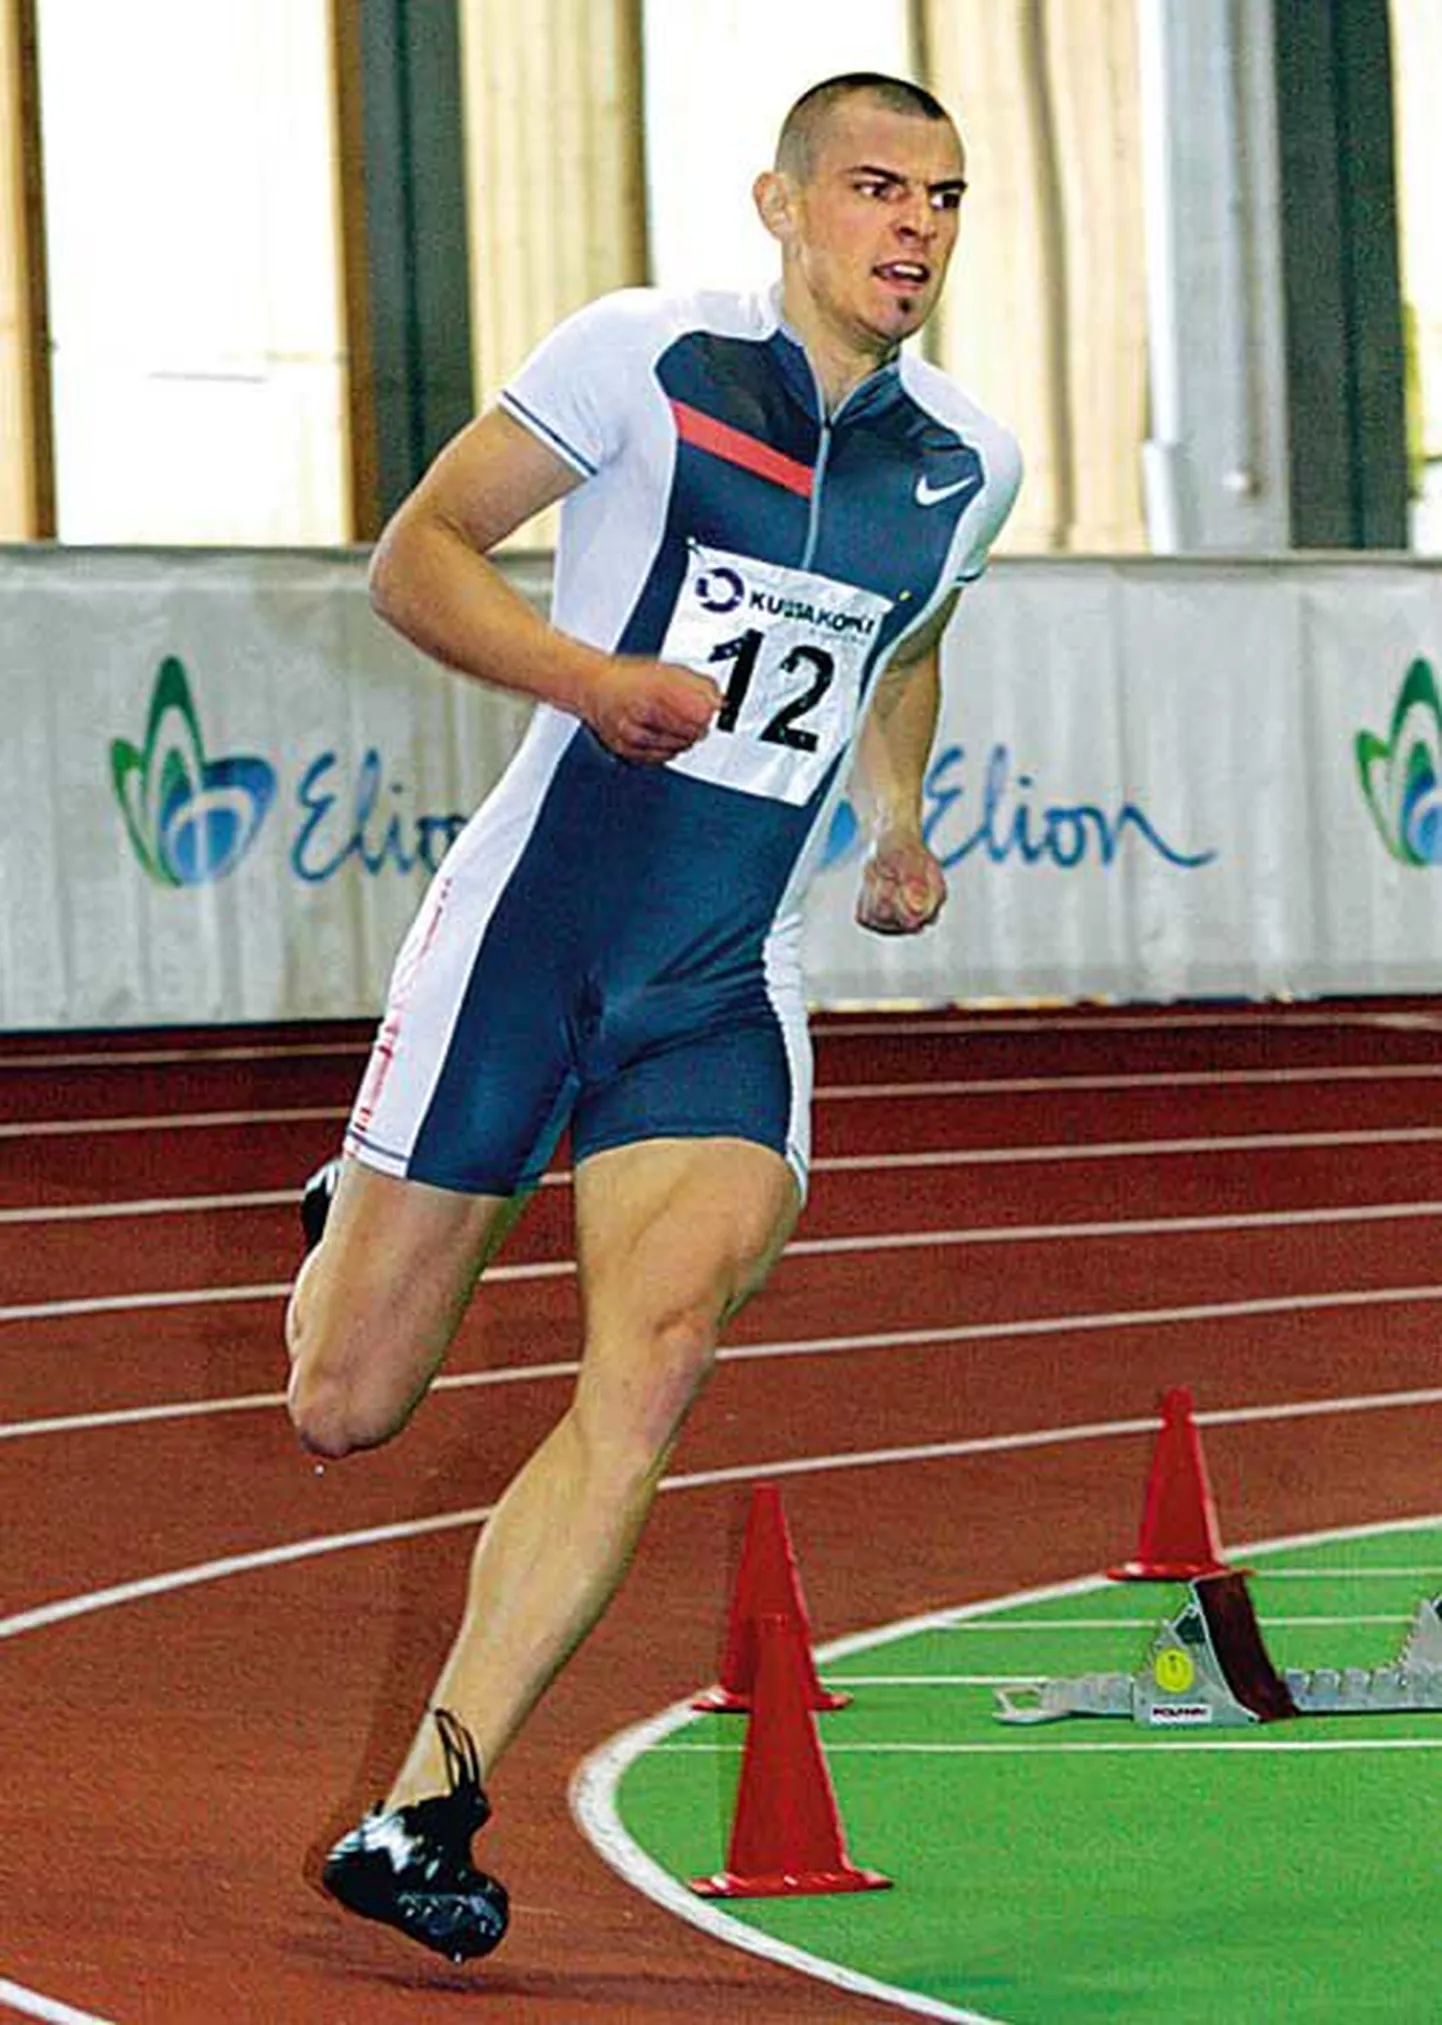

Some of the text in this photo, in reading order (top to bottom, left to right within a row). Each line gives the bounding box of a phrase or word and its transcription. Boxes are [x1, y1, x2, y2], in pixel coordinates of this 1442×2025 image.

[708, 628, 835, 752] 12
[291, 747, 468, 882] Elio
[922, 744, 1218, 869] Elion
